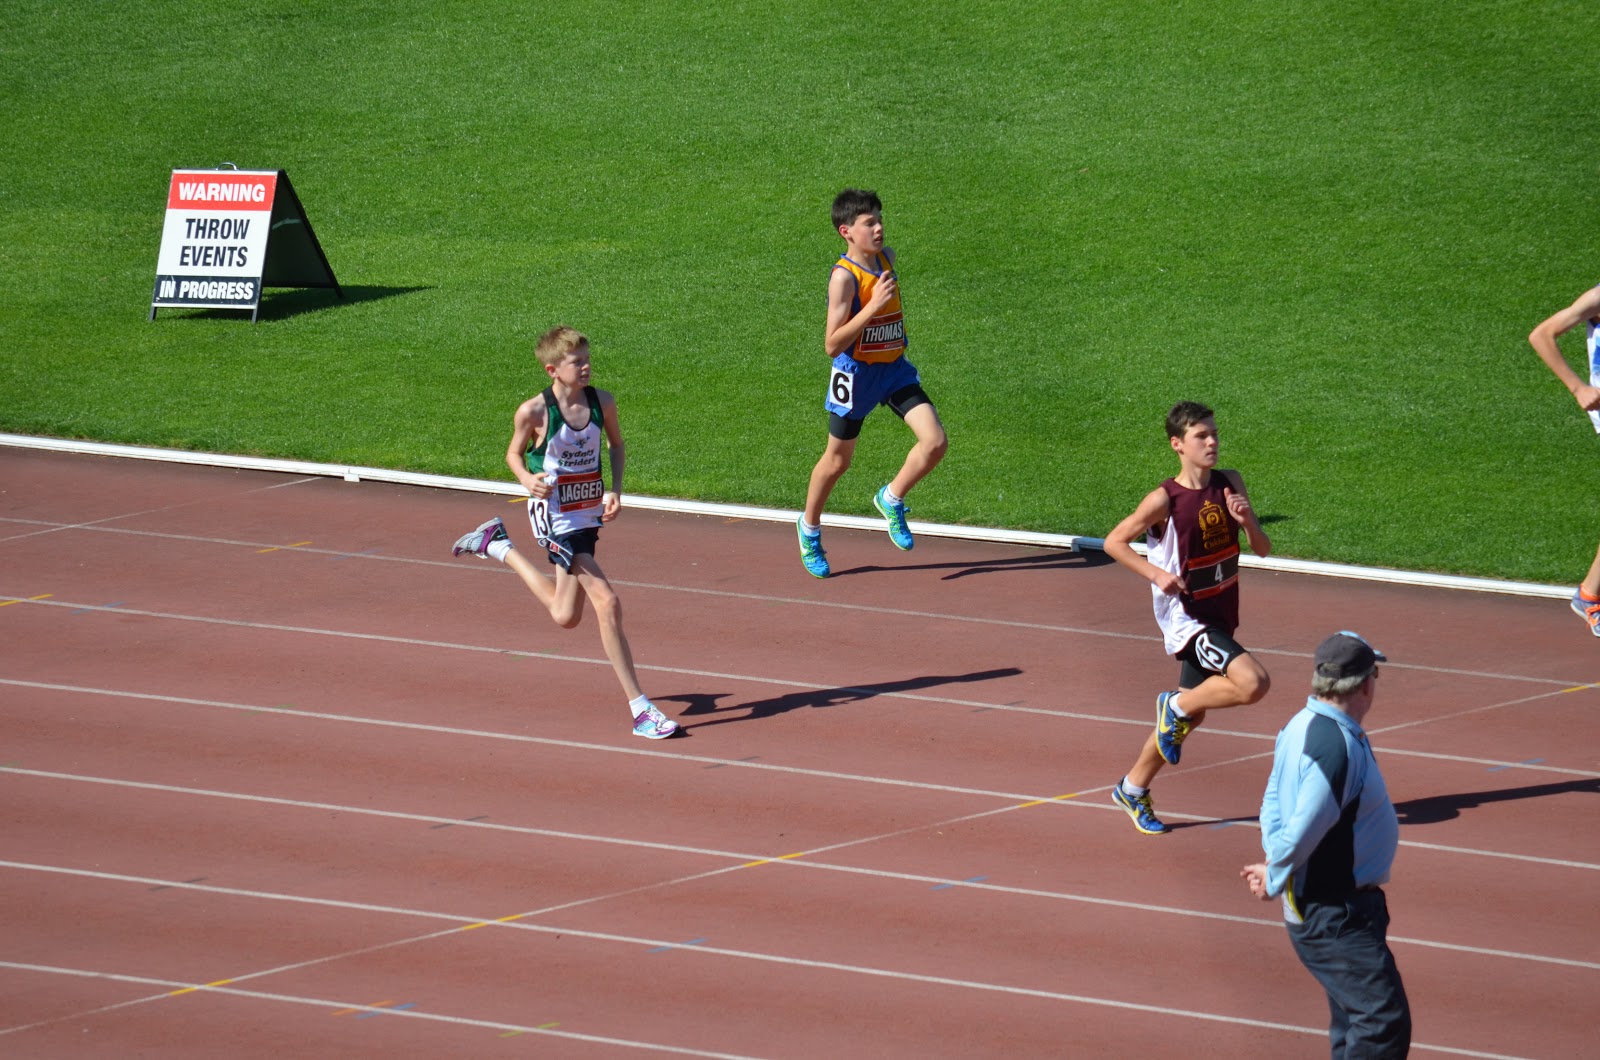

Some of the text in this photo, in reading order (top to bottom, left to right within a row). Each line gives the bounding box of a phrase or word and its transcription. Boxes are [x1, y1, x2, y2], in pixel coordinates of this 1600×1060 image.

[179, 182, 265, 202] WARNING
[185, 218, 250, 240] THROW
[179, 246, 248, 267] EVENTS
[159, 280, 254, 300] IN PROGRESS
[865, 321, 902, 342] THOMAS
[832, 372, 850, 404] 6
[558, 457, 596, 467] Striders
[561, 449, 595, 459] Sydney
[561, 481, 602, 503] JAGGER
[530, 501, 548, 536] 13
[1214, 563, 1223, 582] 4
